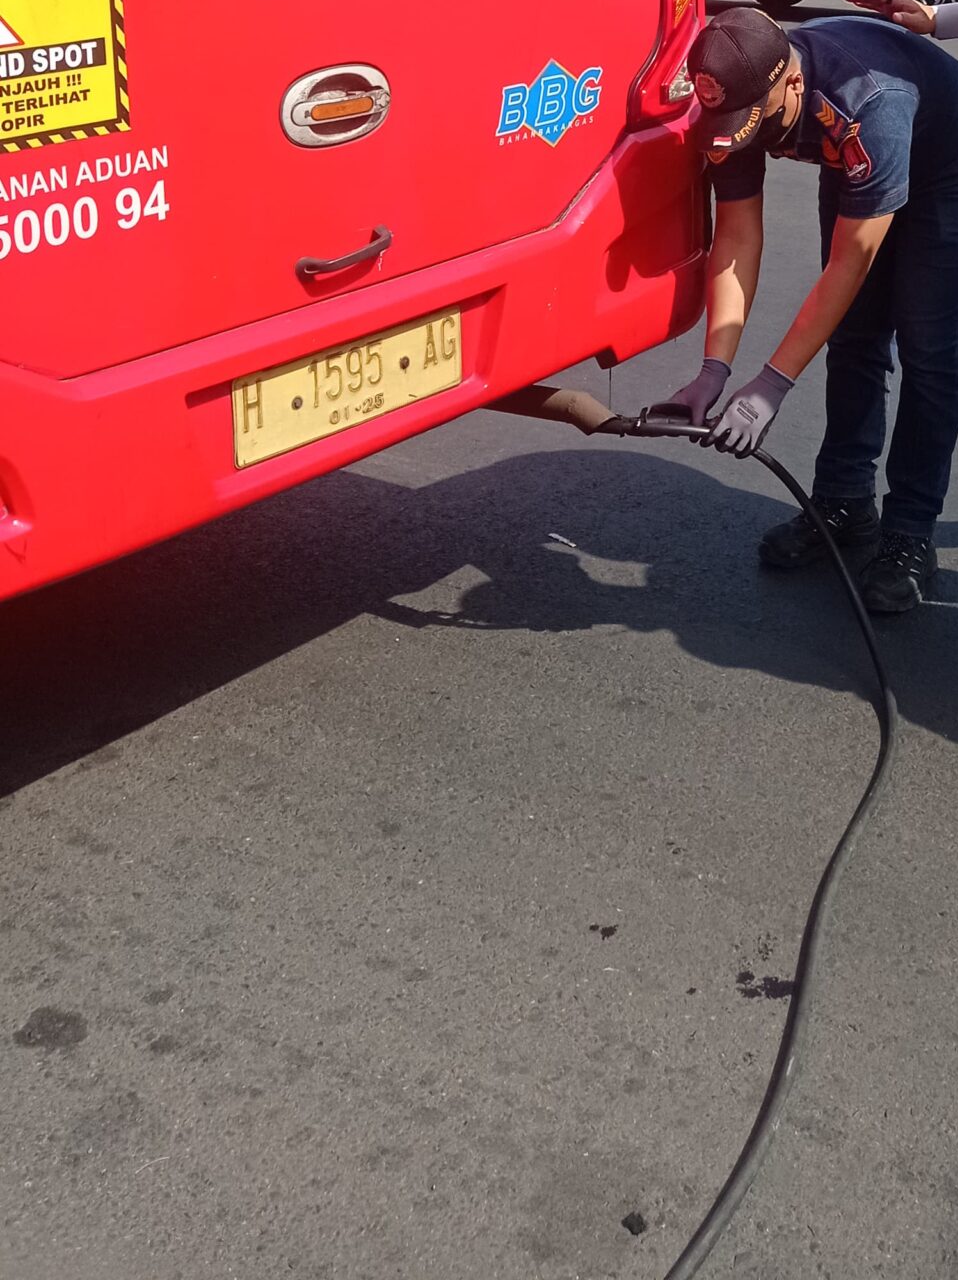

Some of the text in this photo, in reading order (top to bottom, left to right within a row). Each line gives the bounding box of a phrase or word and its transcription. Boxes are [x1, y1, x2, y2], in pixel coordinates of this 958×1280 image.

[32, 41, 98, 73] SPOT
[2, 89, 91, 115] TERLIHAT
[495, 66, 603, 137] BBG
[734, 106, 762, 142] PENGUJI
[75, 145, 169, 186] ADUAN
[115, 179, 170, 230] 94
[242, 316, 457, 434] H 1595 AG
